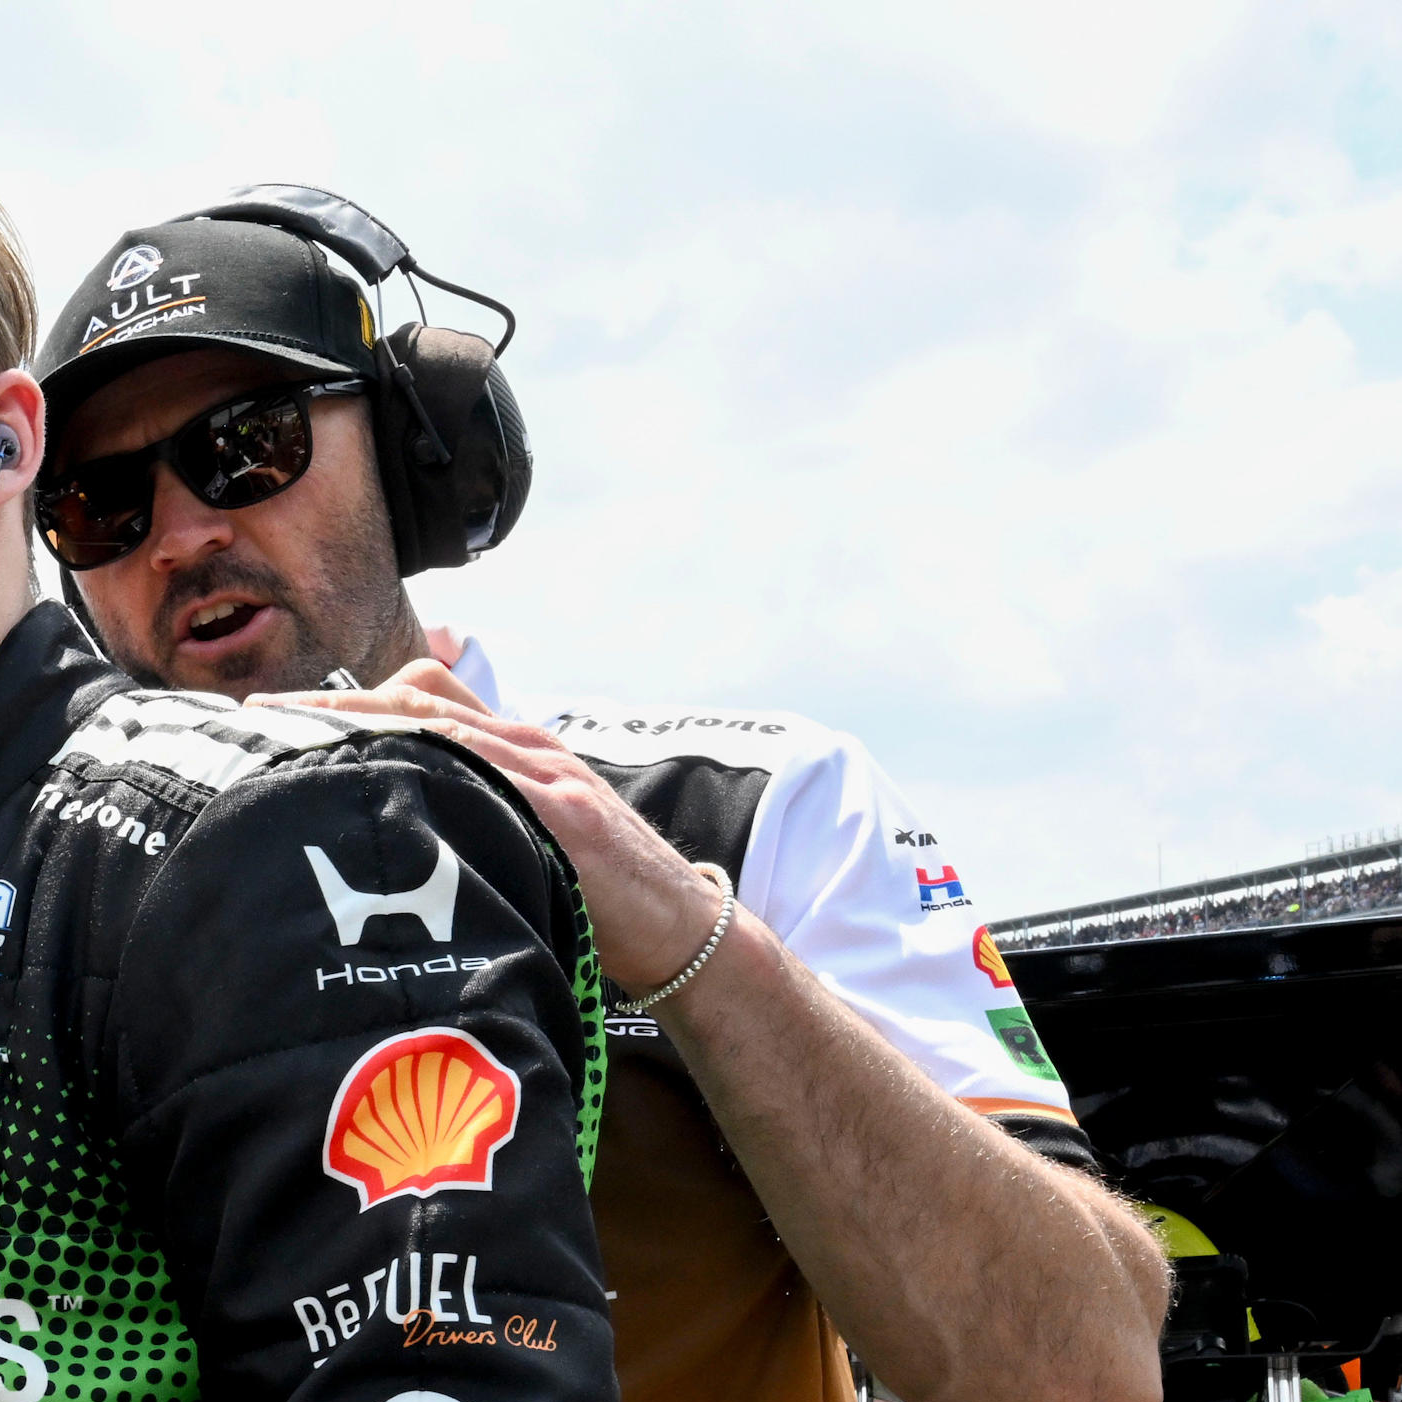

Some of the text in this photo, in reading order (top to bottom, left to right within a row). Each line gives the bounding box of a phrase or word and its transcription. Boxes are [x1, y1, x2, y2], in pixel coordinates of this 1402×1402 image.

[82, 273, 200, 343] AULT
[101, 303, 205, 346] CKCHAIN
[315, 952, 492, 991] Honda
[505, 1315, 557, 1351] Club
